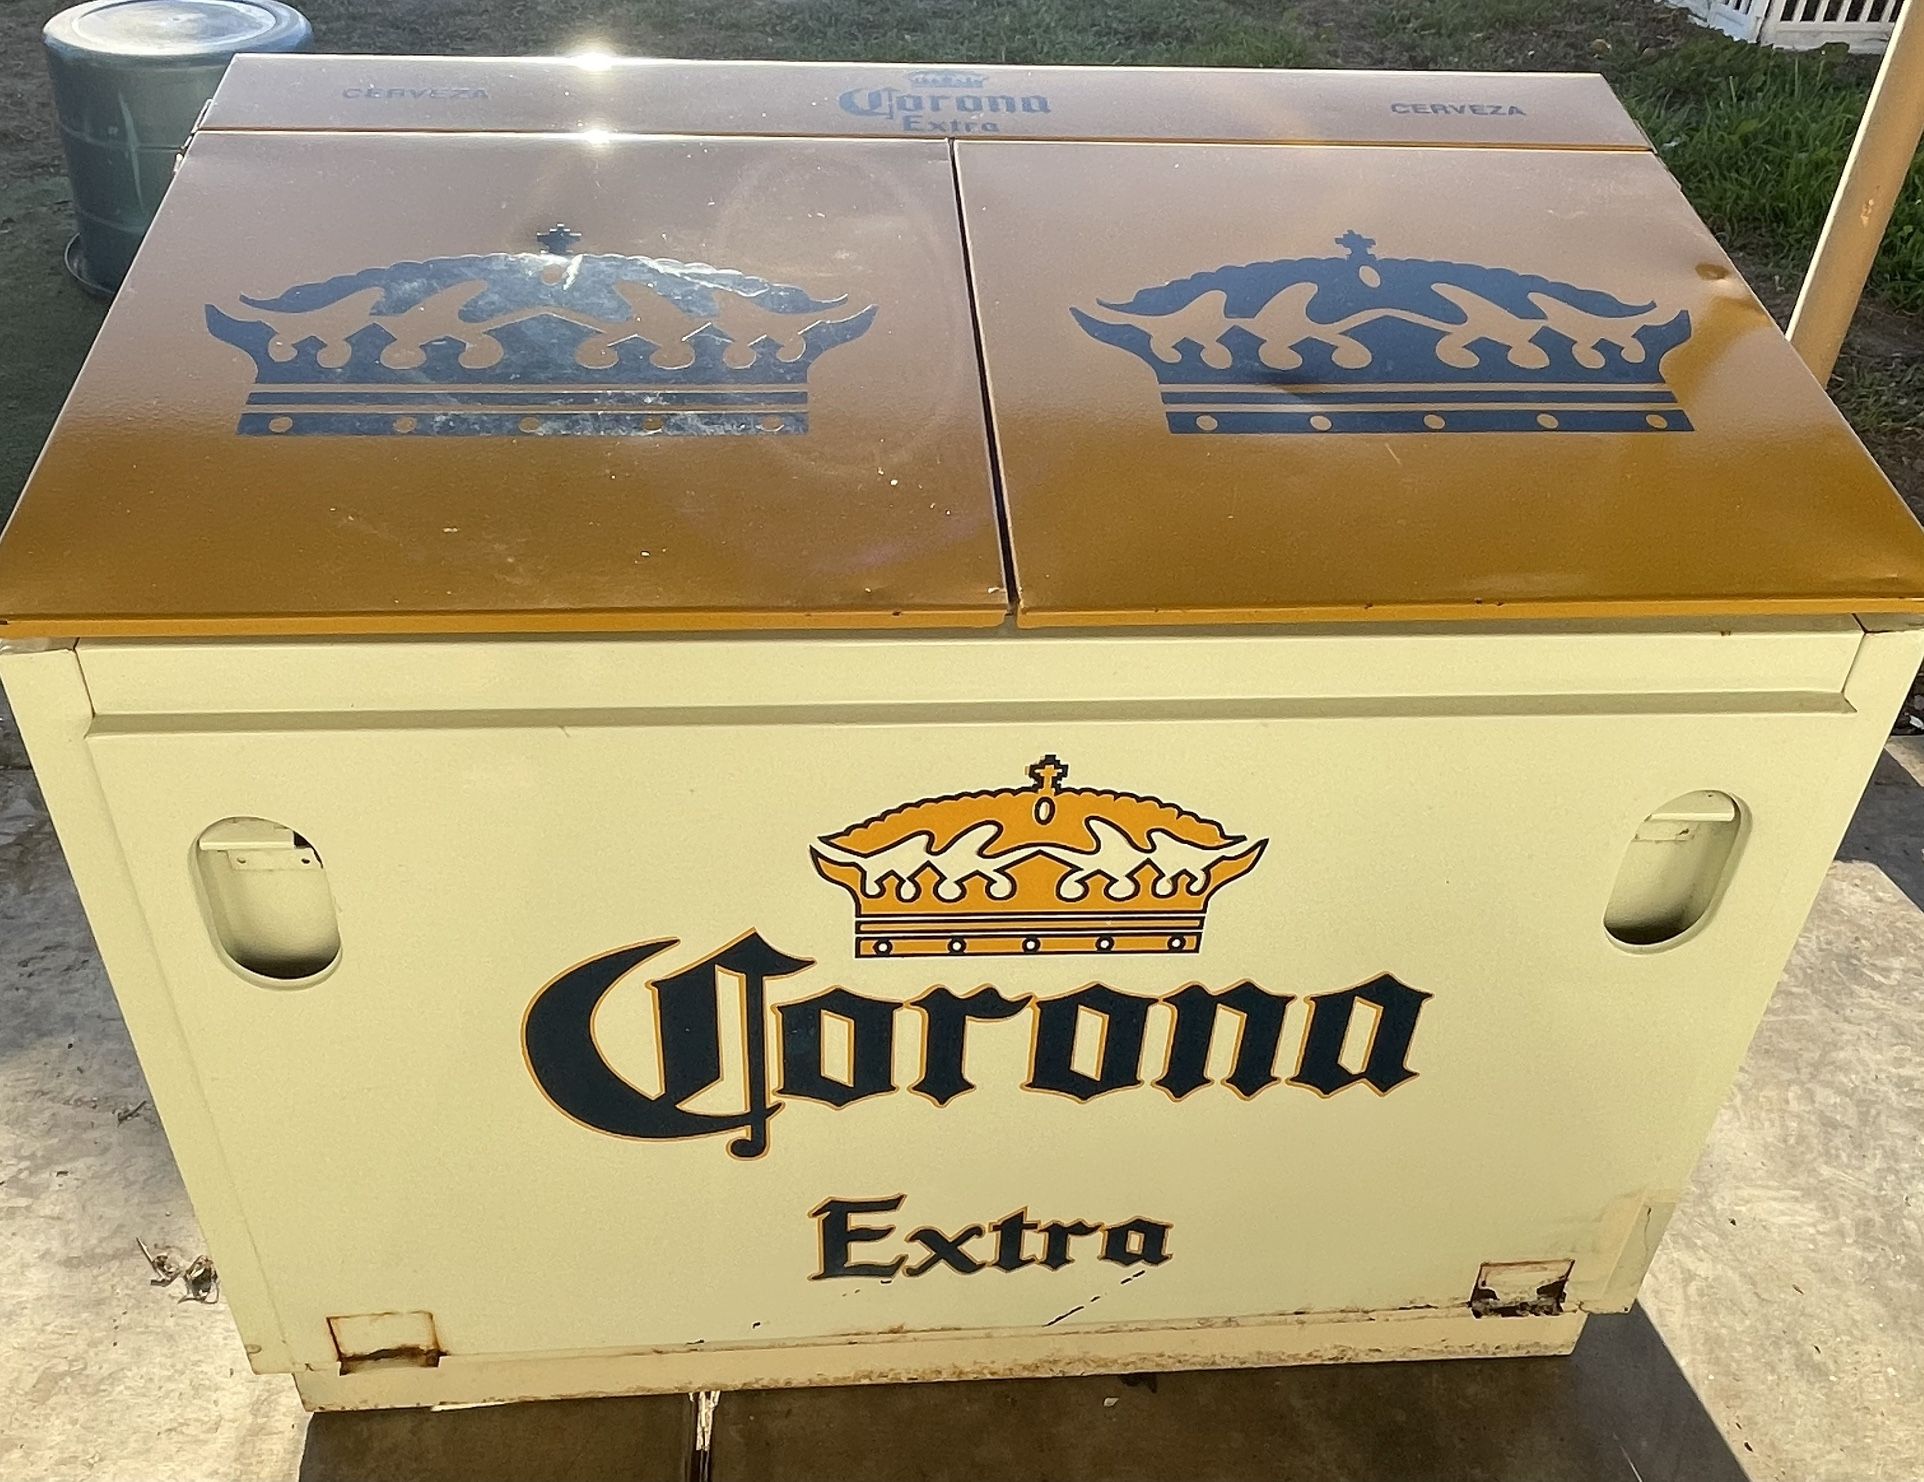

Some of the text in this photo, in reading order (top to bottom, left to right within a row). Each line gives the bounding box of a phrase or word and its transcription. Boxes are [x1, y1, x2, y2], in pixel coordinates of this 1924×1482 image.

[342, 87, 490, 100] CERVEZA
[838, 86, 1052, 121] Corona
[1390, 103, 1527, 116] CERVEZA
[903, 114, 1001, 133] Extra
[520, 927, 1436, 1161] Corona
[807, 1193, 1175, 1282] Extra
